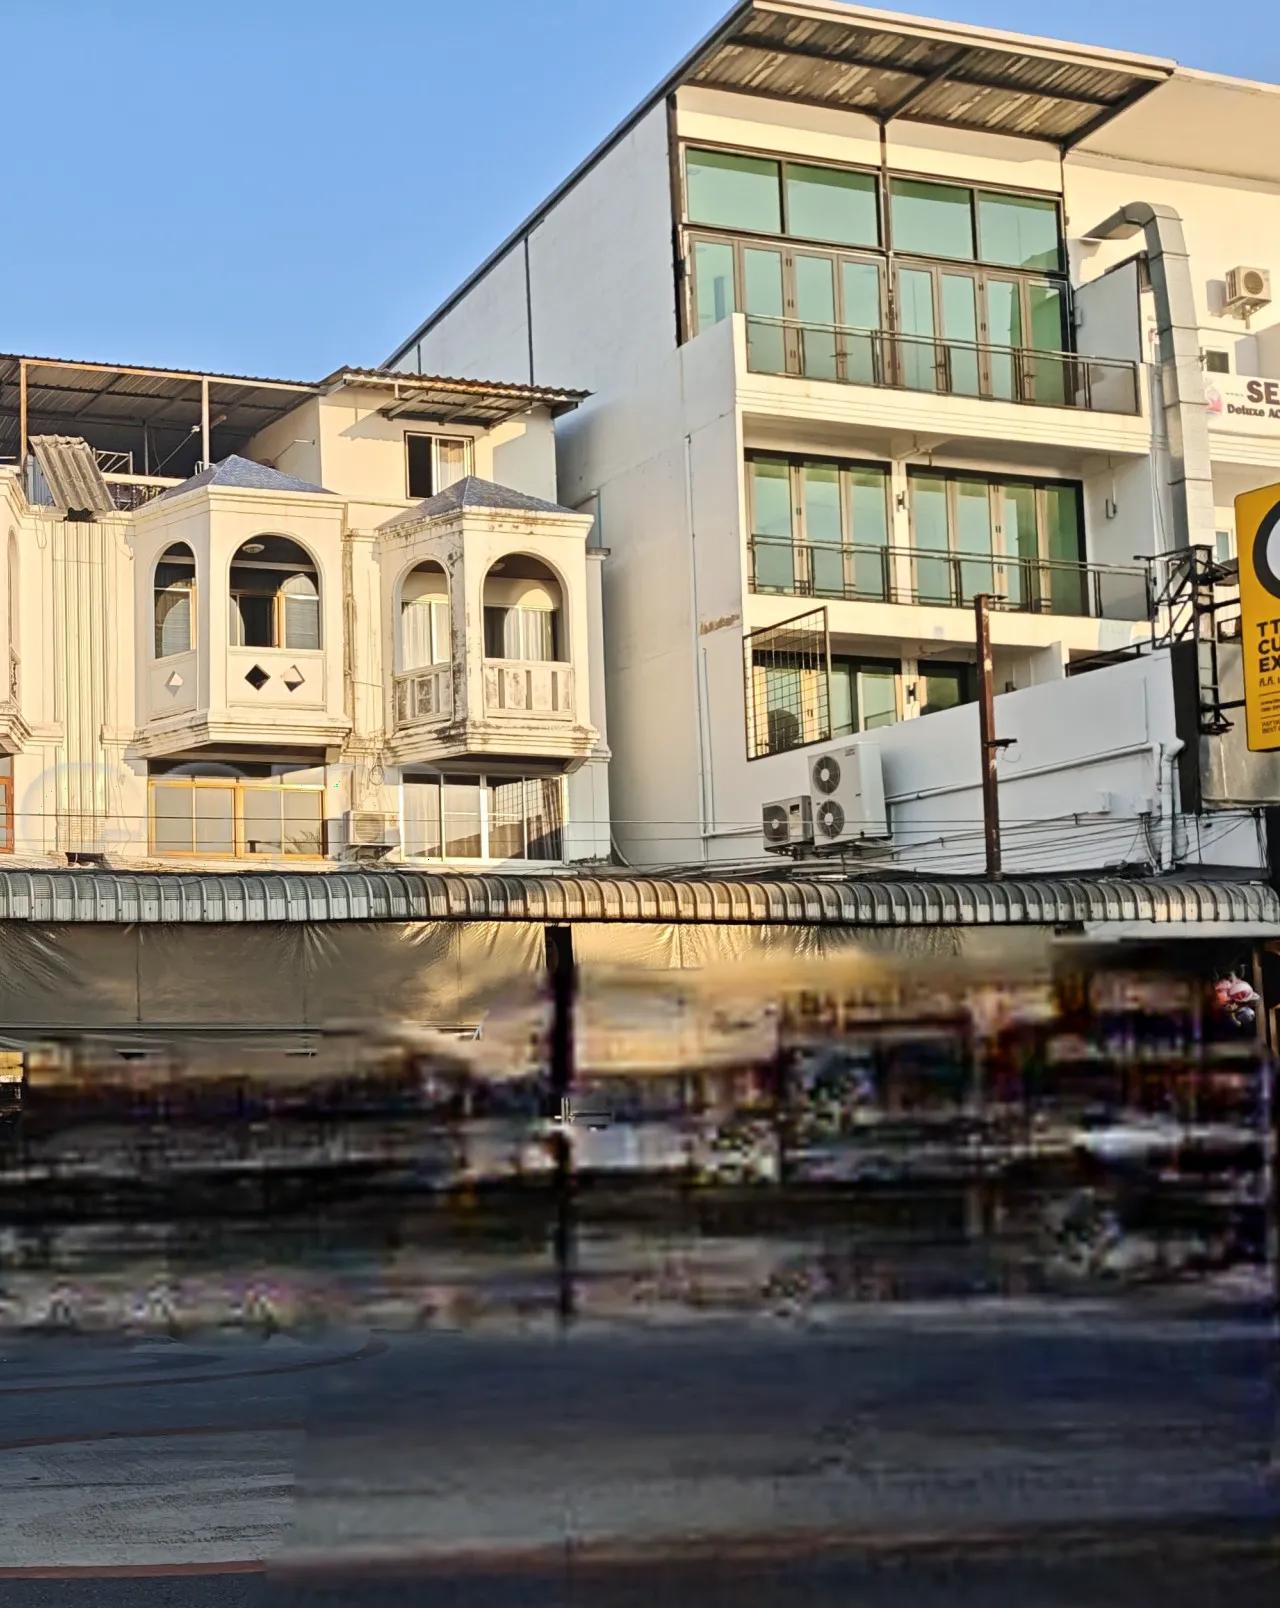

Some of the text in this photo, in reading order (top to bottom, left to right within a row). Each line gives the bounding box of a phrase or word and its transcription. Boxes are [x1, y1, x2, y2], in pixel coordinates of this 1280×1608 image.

[1246, 380, 1280, 405] SE
[1227, 404, 1265, 417] Deluxe
[1256, 619, 1280, 637] TT
[1258, 637, 1280, 655] CU
